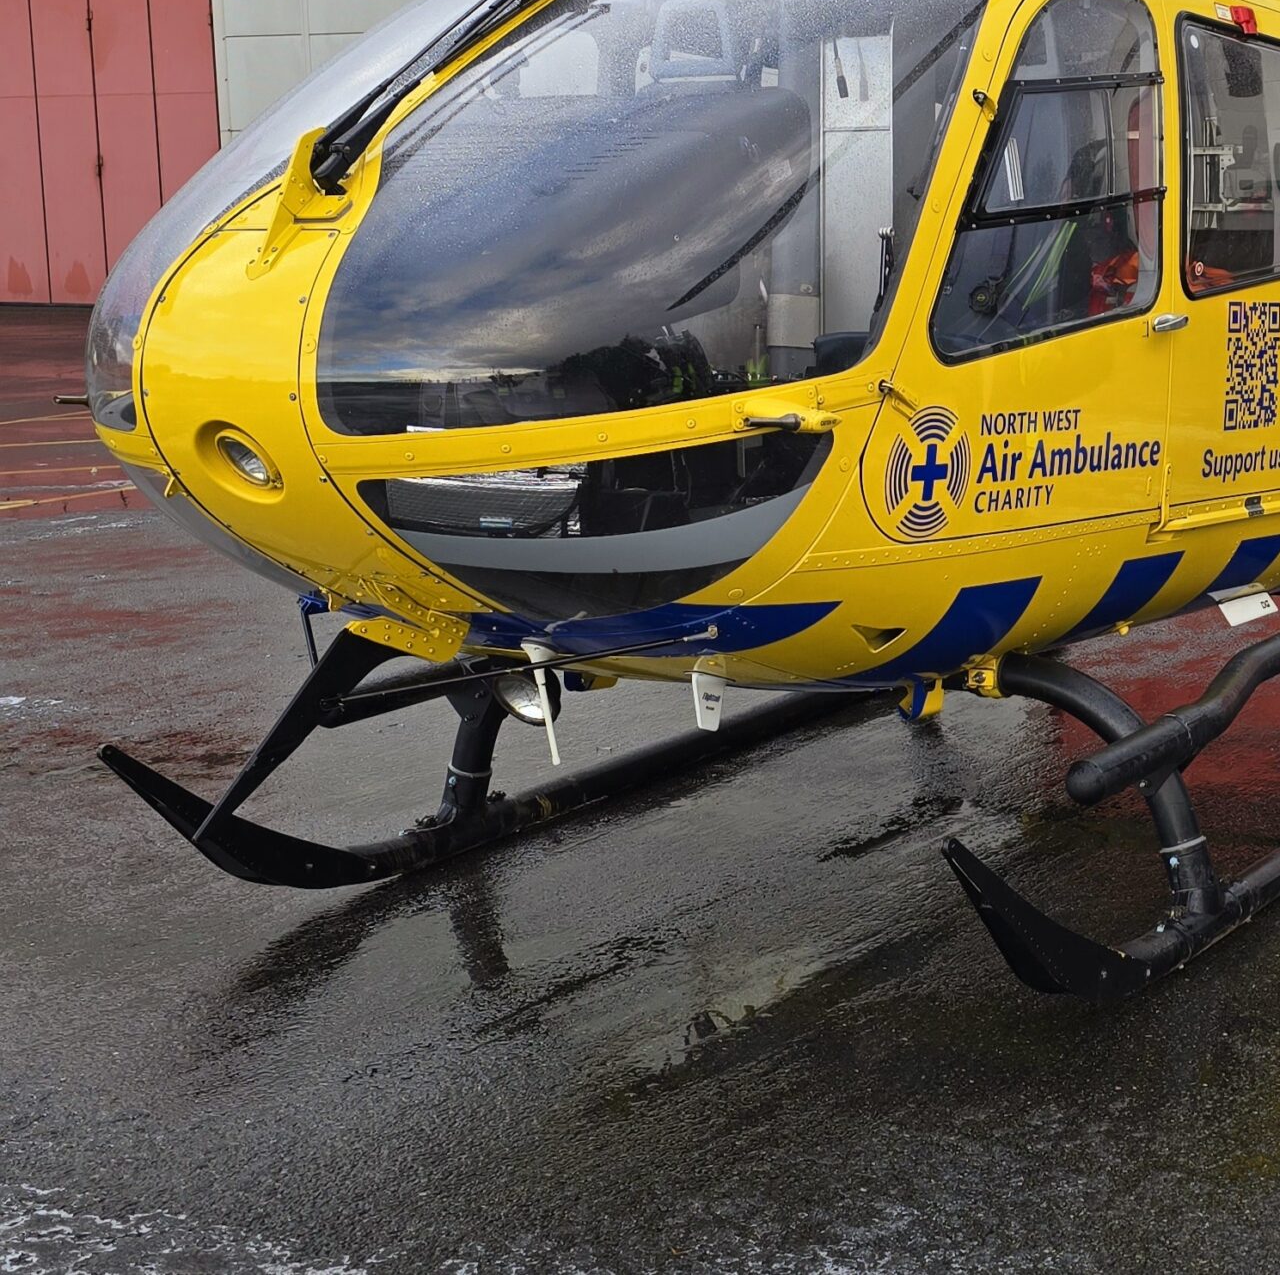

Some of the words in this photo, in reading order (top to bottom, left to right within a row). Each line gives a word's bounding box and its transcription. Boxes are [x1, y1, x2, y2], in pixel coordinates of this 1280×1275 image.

[980, 411, 1038, 436] NORTH
[1043, 409, 1081, 432] WEST
[976, 439, 1022, 484] Air
[1028, 431, 1161, 479] Ambulance
[1202, 445, 1266, 483] Support
[974, 484, 1055, 513] CHARITY
